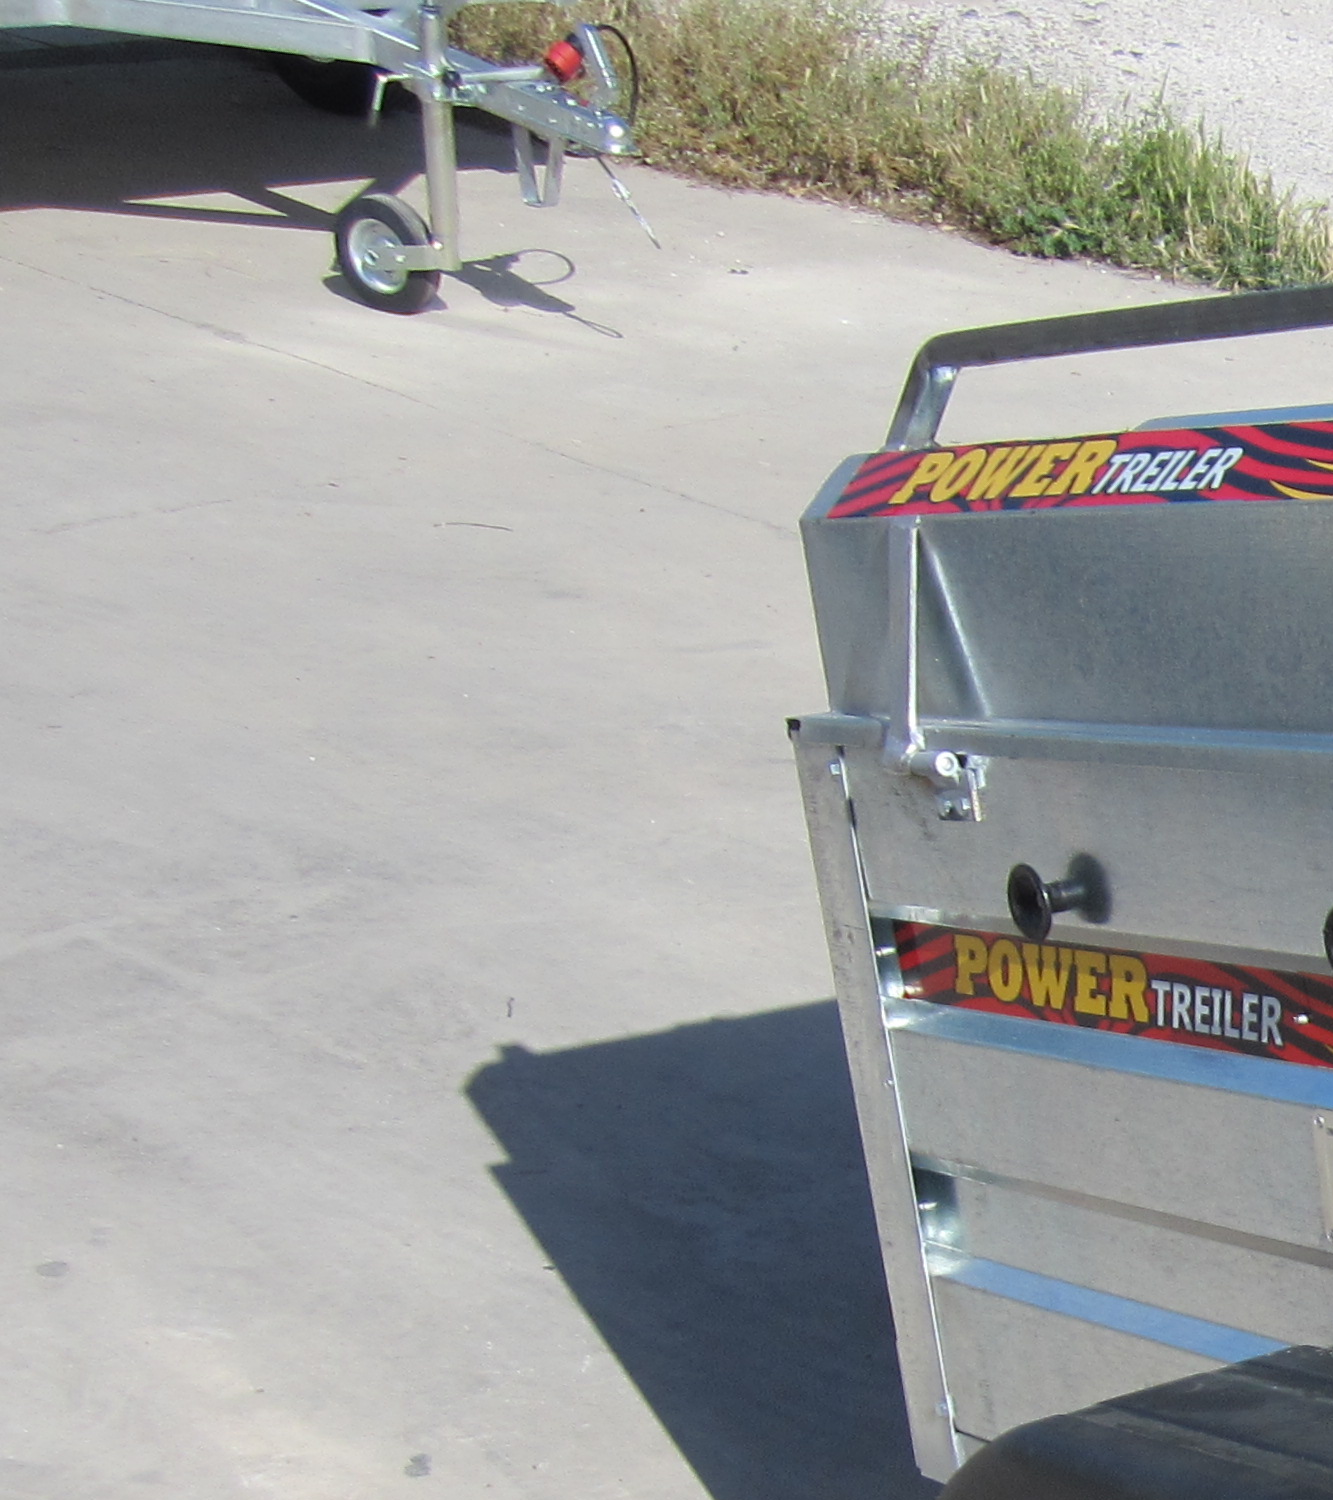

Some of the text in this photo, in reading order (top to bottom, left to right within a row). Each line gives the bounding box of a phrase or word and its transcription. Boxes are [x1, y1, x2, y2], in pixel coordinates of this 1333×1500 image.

[889, 439, 1243, 505] POWER TREILER
[953, 934, 1284, 1047] POWER TREILER
